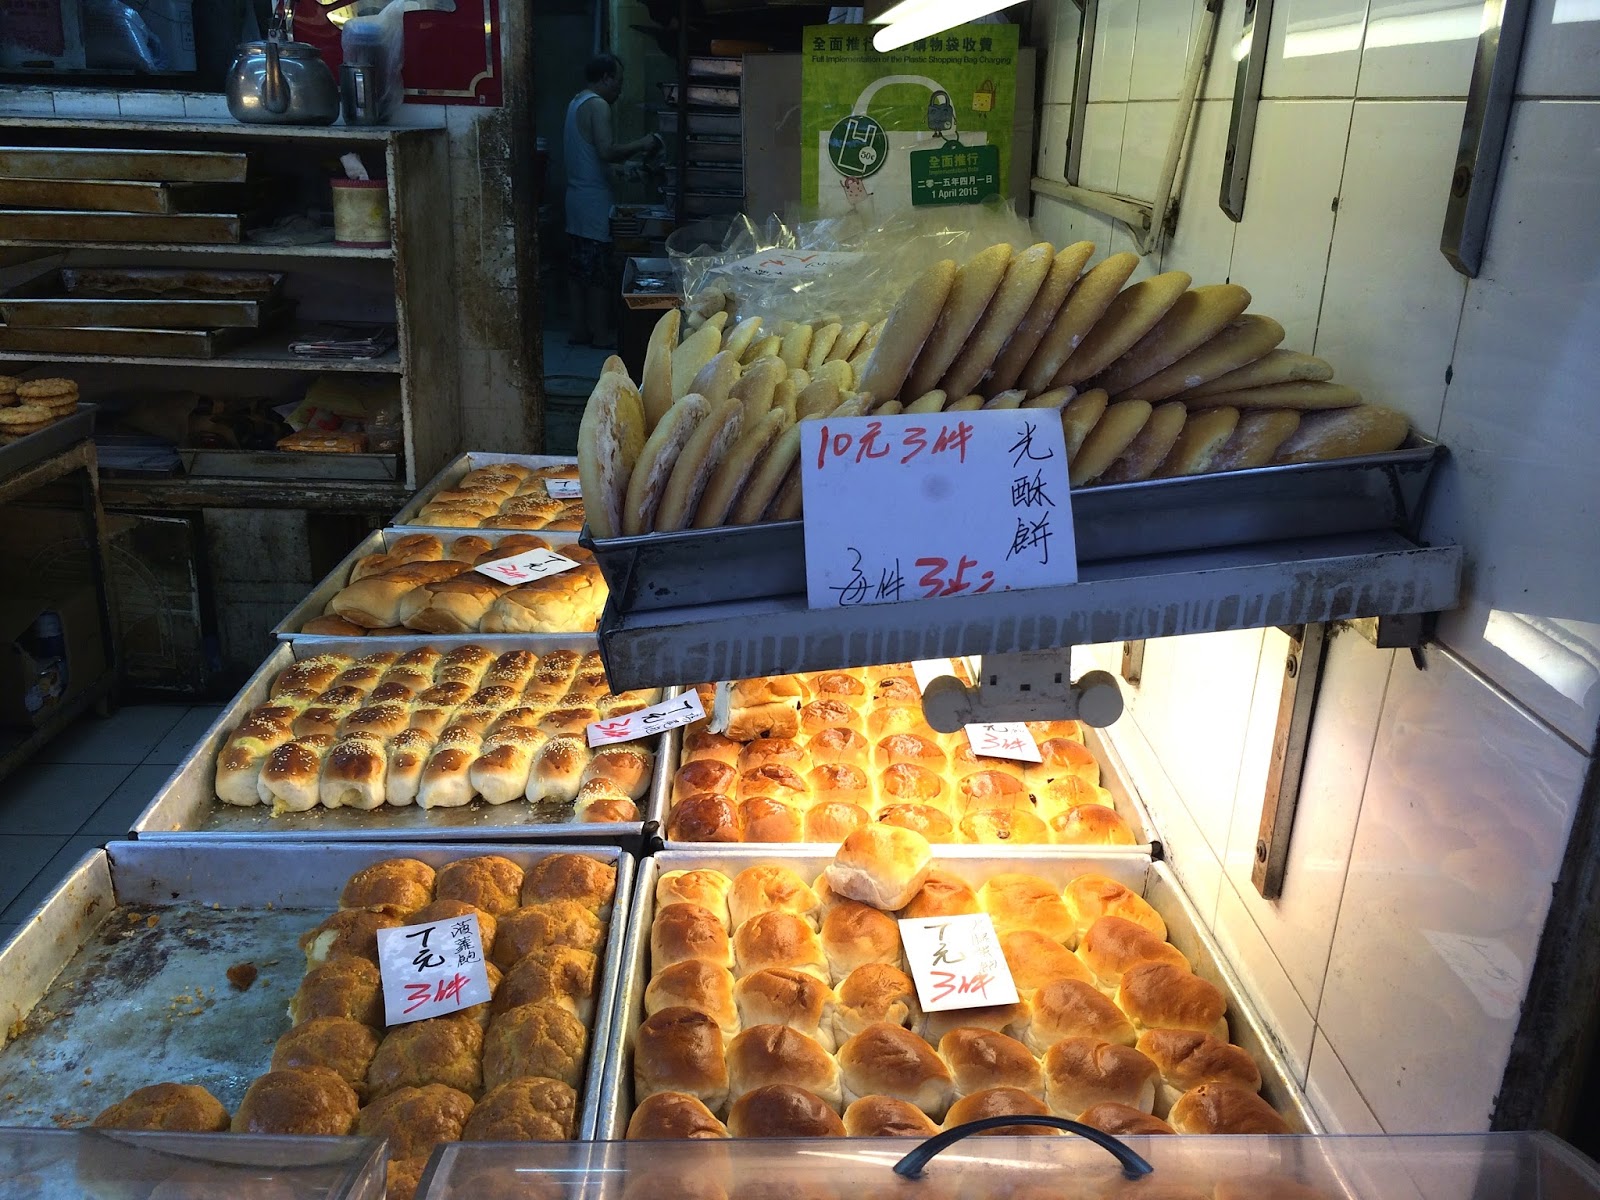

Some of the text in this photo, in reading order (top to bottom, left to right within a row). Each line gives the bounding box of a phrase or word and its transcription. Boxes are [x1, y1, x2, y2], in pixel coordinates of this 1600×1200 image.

[812, 36, 992, 52] 全面推行購物袋收費
[812, 55, 1011, 65] Full Implementation of the Plastic Shopping Bag Charging
[928, 153, 979, 168] 全面推行
[931, 187, 978, 199] 1 April 2015
[1005, 420, 1056, 566] 光酥餅
